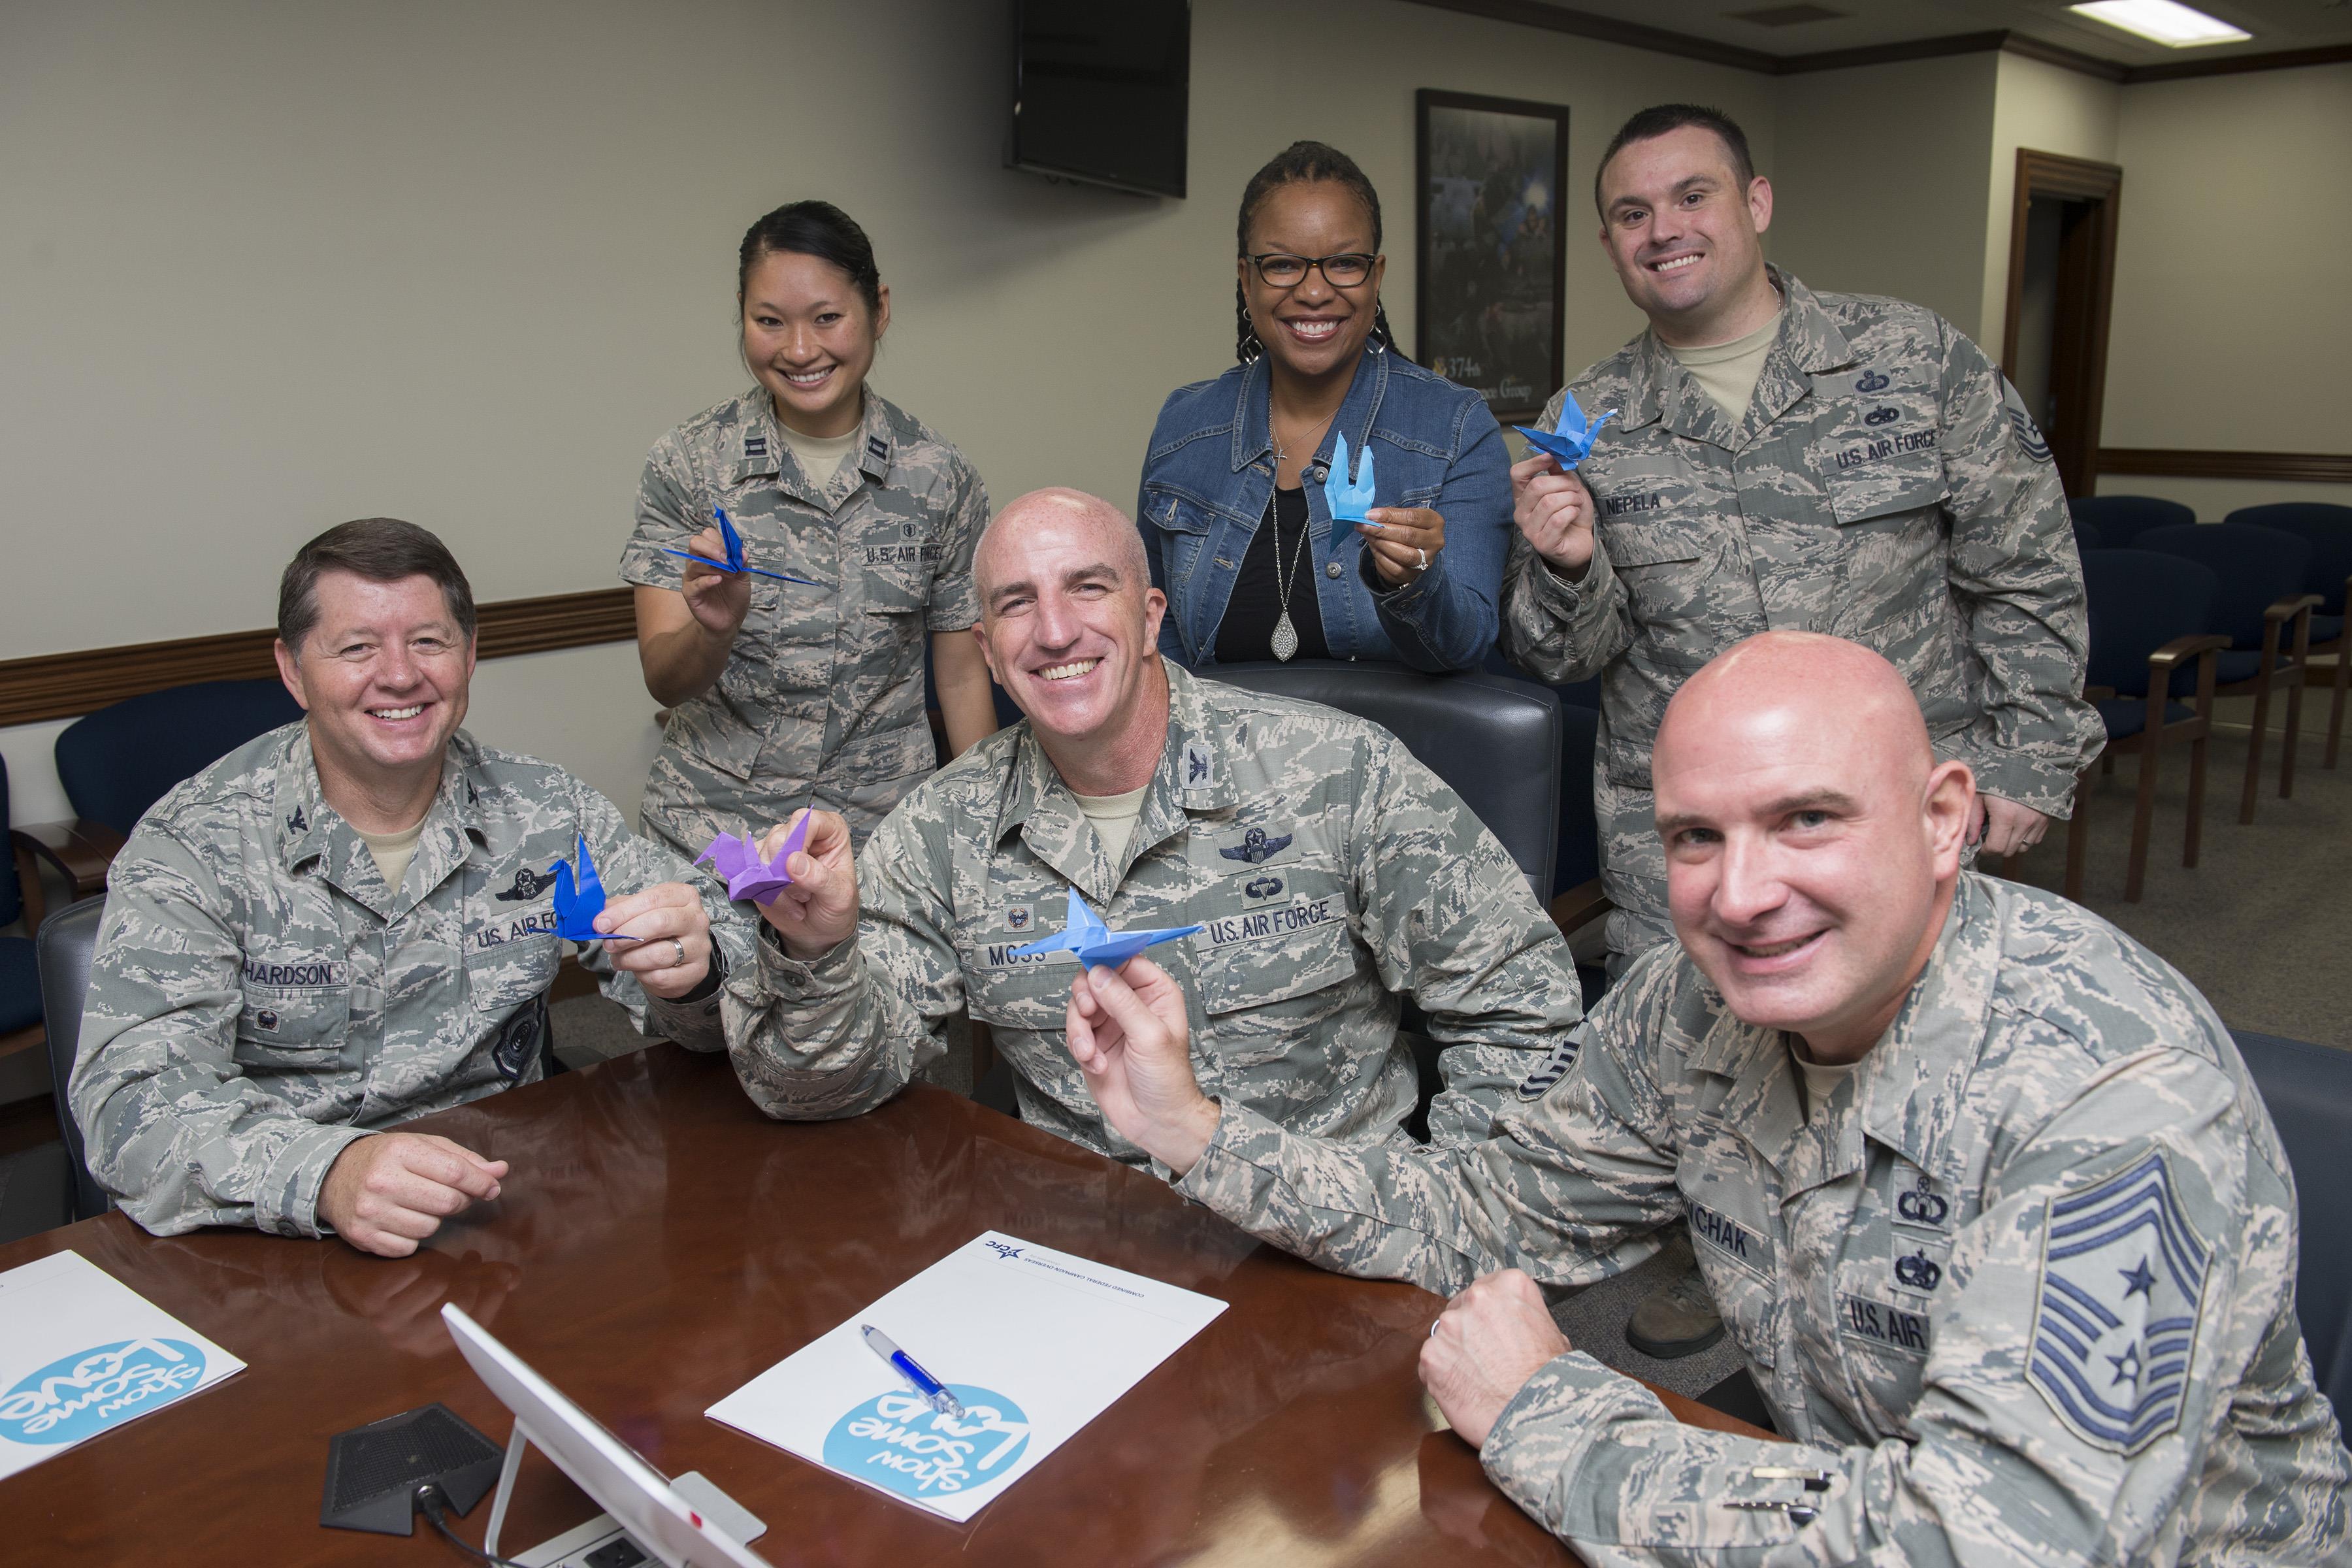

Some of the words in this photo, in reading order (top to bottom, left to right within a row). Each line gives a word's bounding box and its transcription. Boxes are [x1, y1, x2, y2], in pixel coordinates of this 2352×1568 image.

[1500, 378, 1532, 402] Group
[1837, 448, 1865, 469] U.S.
[1869, 439, 1895, 460] AIR
[1895, 429, 1936, 452] FORCE
[1606, 492, 1661, 514] NEPELA
[898, 547, 915, 562] AIR
[477, 928, 504, 948] U.S.
[510, 917, 538, 941] AIR
[1211, 920, 1239, 944] U.S.
[1243, 914, 1271, 939] AIR
[1273, 900, 1331, 933] FORCE
[985, 1241, 1011, 1251] CFC
[1086, 1277, 1112, 1289] FEDERAL
[1112, 1285, 1145, 1298] COMBINED
[1850, 1299, 1885, 1339] U.S.
[1889, 1310, 1926, 1350] AIR
